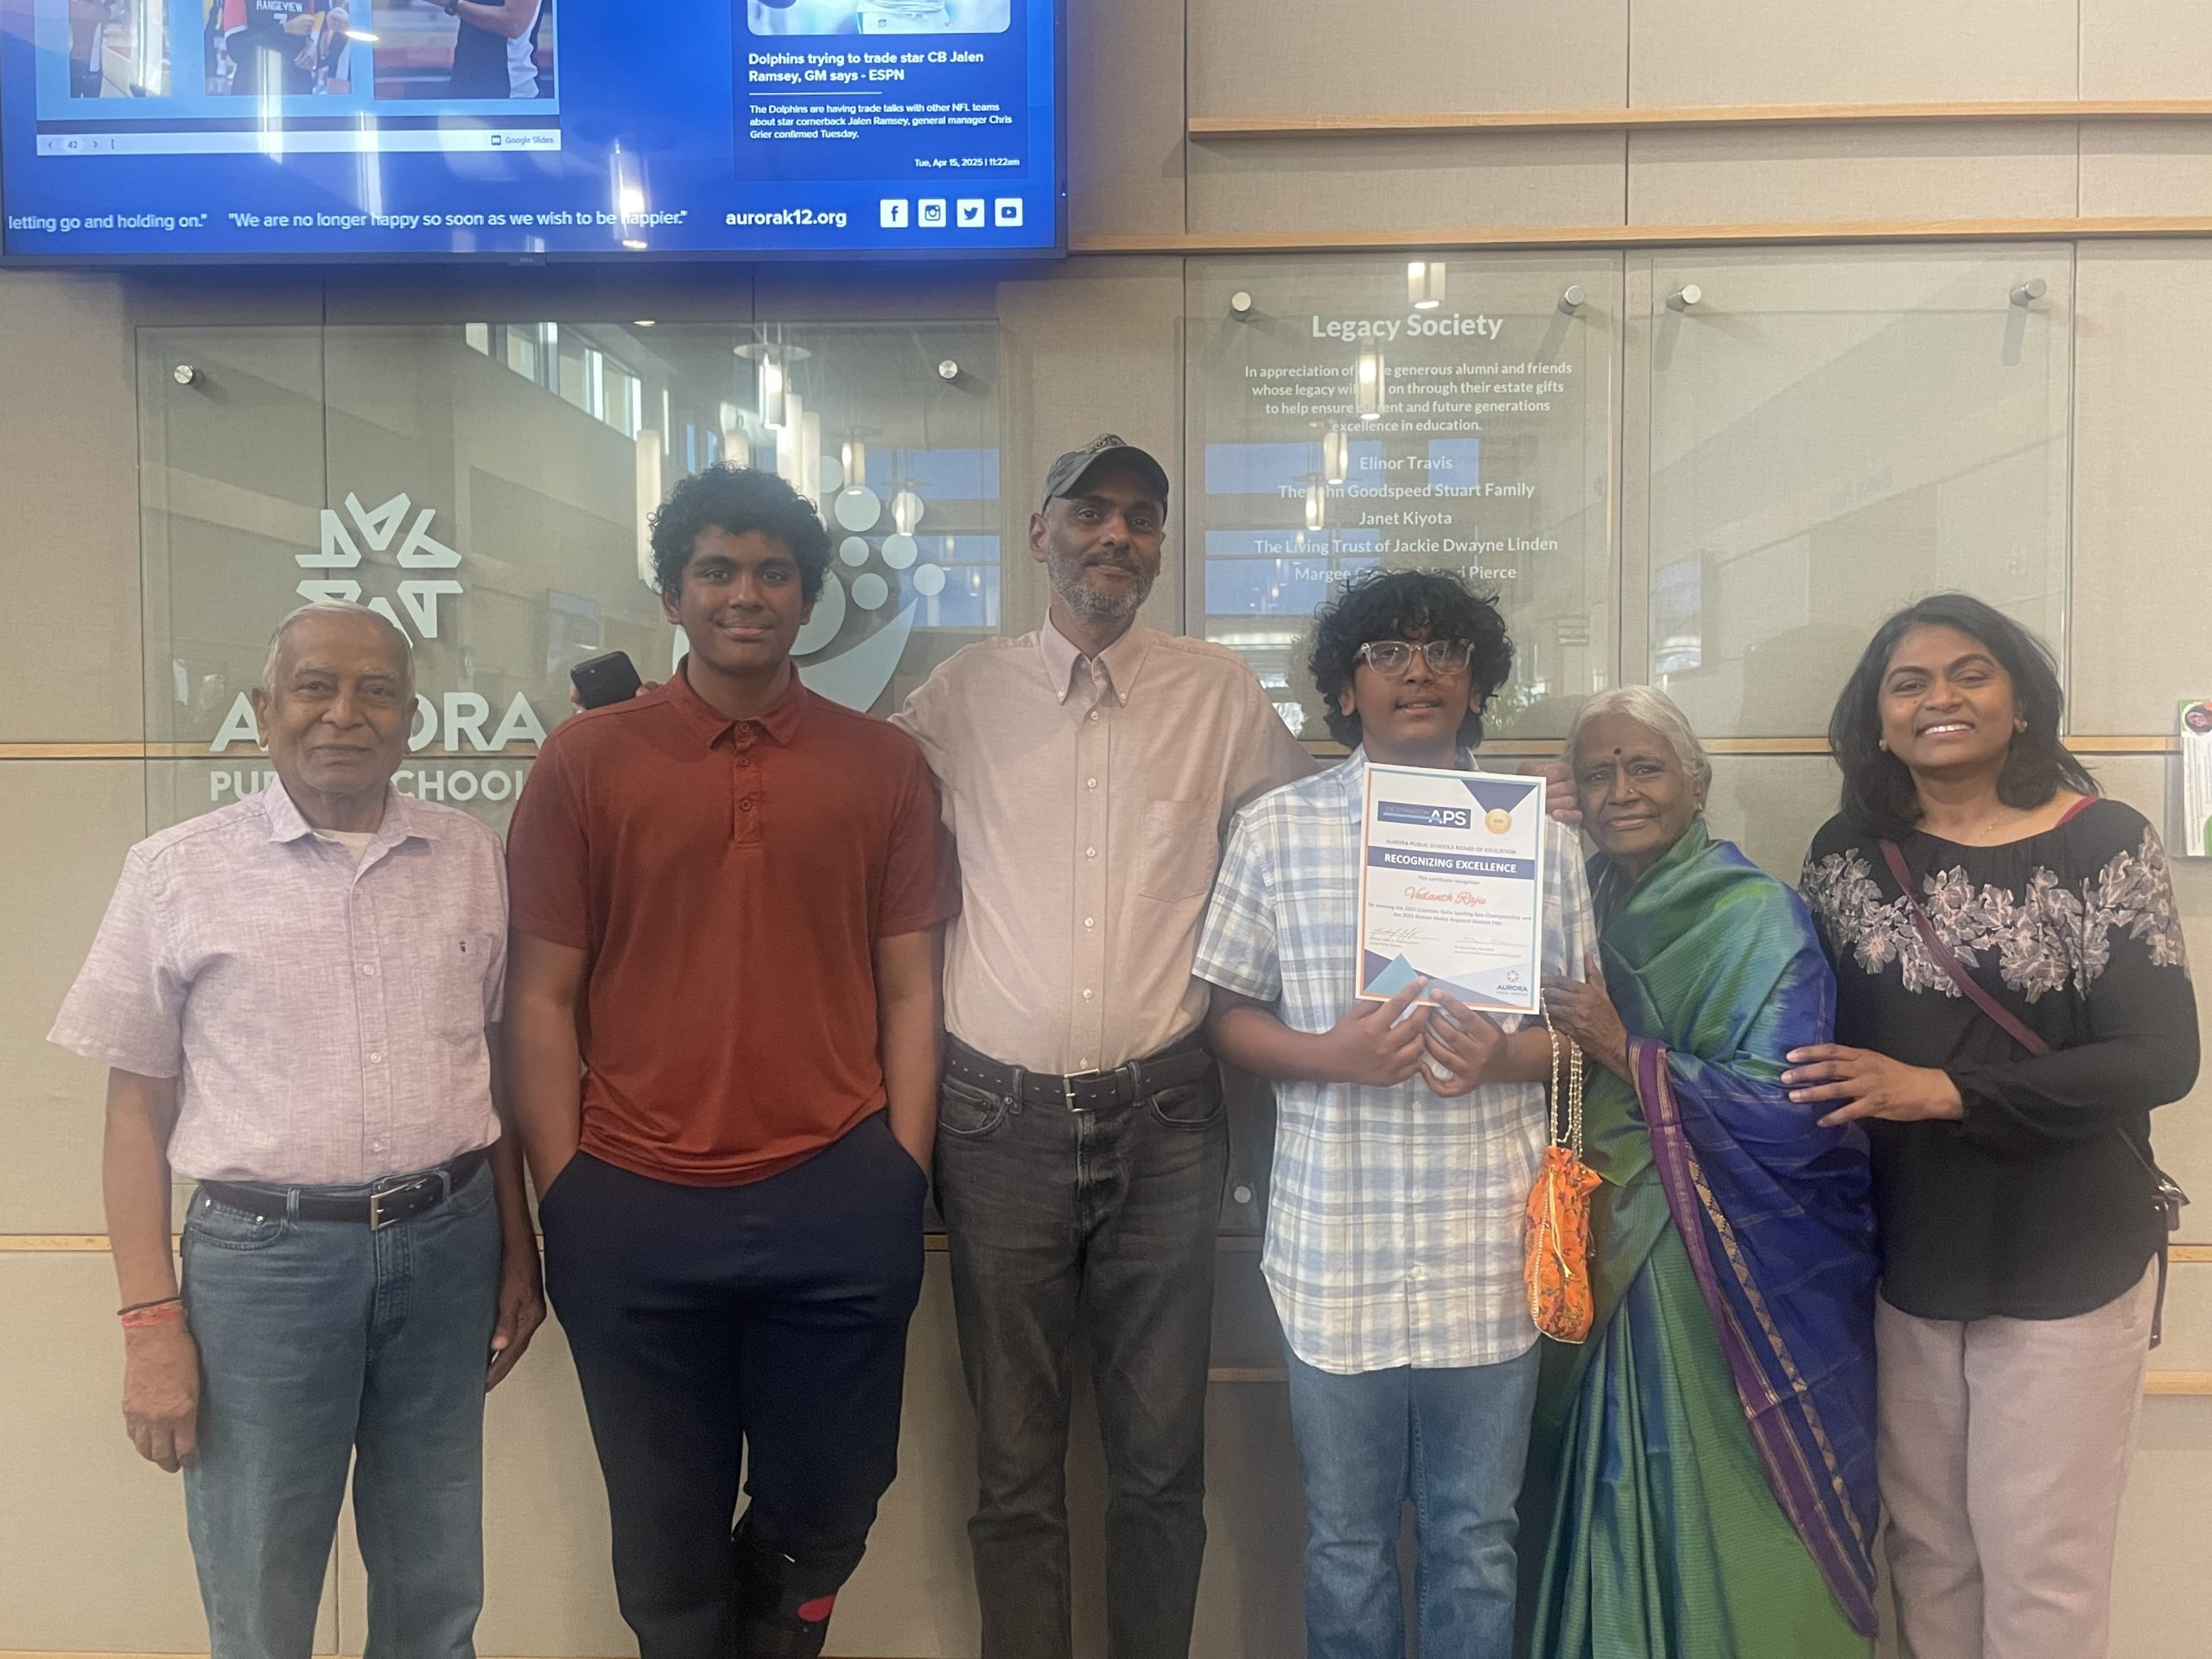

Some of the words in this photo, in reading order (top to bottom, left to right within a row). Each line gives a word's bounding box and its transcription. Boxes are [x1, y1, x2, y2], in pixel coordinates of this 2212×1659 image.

[748, 53, 804, 66] Dolphins
[807, 54, 844, 67] trying
[848, 54, 861, 64] to
[863, 53, 898, 63] trade
[900, 54, 925, 63] star
[927, 52, 946, 63] CB
[950, 51, 984, 62] Jalen
[748, 71, 802, 84] Ramsey,
[804, 70, 827, 81] GM
[830, 73, 858, 84] says
[868, 69, 905, 80] ESPN
[749, 105, 767, 114] The
[768, 105, 808, 115] Dolphins
[826, 104, 856, 115] having
[858, 104, 881, 113] trade
[883, 104, 905, 112] talks
[906, 103, 925, 112] with
[926, 103, 950, 112] other
[951, 103, 970, 111] NFL
[972, 103, 1000, 111] teams
[749, 118, 776, 126] about
[777, 118, 794, 126] star
[796, 117, 846, 126] cornerback
[848, 117, 872, 125] Jalen
[874, 116, 910, 127] Ramsey,
[912, 116, 946, 127] general
[948, 116, 987, 127] manager
[988, 115, 1013, 124] Chris
[505, 136, 531, 146] Google
[532, 136, 554, 144] Slides
[750, 130, 772, 139] Grier
[774, 130, 818, 139] confirmed
[820, 130, 859, 141] Tuesday.
[914, 159, 931, 168] Tue,
[932, 158, 947, 168] Apr
[949, 158, 960, 168] 15,
[961, 158, 983, 167] 2025
[989, 157, 1020, 167] 11:22am
[8, 215, 56, 232] letting
[60, 219, 81, 232] go
[85, 215, 114, 228] and
[118, 214, 175, 230] holding
[264, 217, 289, 226] are
[293, 217, 314, 226] no
[317, 213, 367, 229] longer
[371, 213, 417, 229] happy
[423, 215, 441, 226] so
[445, 214, 484, 226] soon
[487, 214, 506, 225] as
[509, 214, 533, 225] we
[537, 211, 571, 225] wish
[576, 213, 592, 225] to
[596, 211, 617, 224] be
[725, 209, 848, 228] aurorak12.org
[1312, 314, 1401, 342] Legacy
[1406, 313, 1503, 340] Society
[1245, 365, 1257, 378] In
[1260, 365, 1338, 380] appreciation
[1341, 365, 1355, 377] of
[1394, 366, 1452, 379] generous
[1455, 364, 1498, 376] alumni
[1501, 363, 1525, 375] and
[1528, 362, 1573, 374] friends
[1252, 385, 1293, 396] whose
[1295, 384, 1334, 398] legacy
[1388, 385, 1405, 395] on
[1408, 382, 1458, 397] through
[1460, 382, 1491, 394] their
[1493, 383, 1534, 393] estate
[1536, 380, 1564, 396] gifts
[1266, 403, 1279, 415] to
[1281, 402, 1309, 416] help
[1311, 404, 1354, 415] ensure
[1406, 401, 1429, 413] and
[1432, 400, 1472, 412] future
[1475, 400, 1550, 415] generations
[1332, 419, 1398, 432] excellence
[1402, 419, 1413, 431] in
[1415, 418, 1482, 431] education.
[1359, 456, 1403, 470] Elinor
[1407, 455, 1453, 469] Travis
[1278, 485, 1306, 499] The
[1307, 484, 1344, 499] hn
[1347, 482, 1432, 500] Goodspeed
[1434, 483, 1481, 497] Stuart
[1484, 481, 1535, 499] Family
[1358, 512, 1400, 525] Janet
[1403, 511, 1452, 528] Kiyota
[1254, 539, 1282, 554] The
[1286, 539, 1329, 556] Living
[1332, 539, 1372, 553] Trust
[1375, 538, 1392, 552] of
[1393, 538, 1440, 552] Jackie
[1443, 539, 1504, 556] Dwayne
[1508, 537, 1559, 551] Linden
[1295, 567, 1351, 582] Margee
[1469, 566, 1517, 579] Pierce
[210, 691, 547, 752] AORA
[1428, 809, 1466, 826] APS
[1386, 838, 1409, 847] AURORA
[1409, 841, 1428, 849] PUBLIC
[1429, 842, 1454, 851] SCHOOLS
[1484, 847, 1516, 855] EDUCATION
[1384, 853, 1453, 868] RECOGNIZING
[1456, 861, 1516, 874] EXCELLENCE
[1454, 892, 1487, 907] Raju
